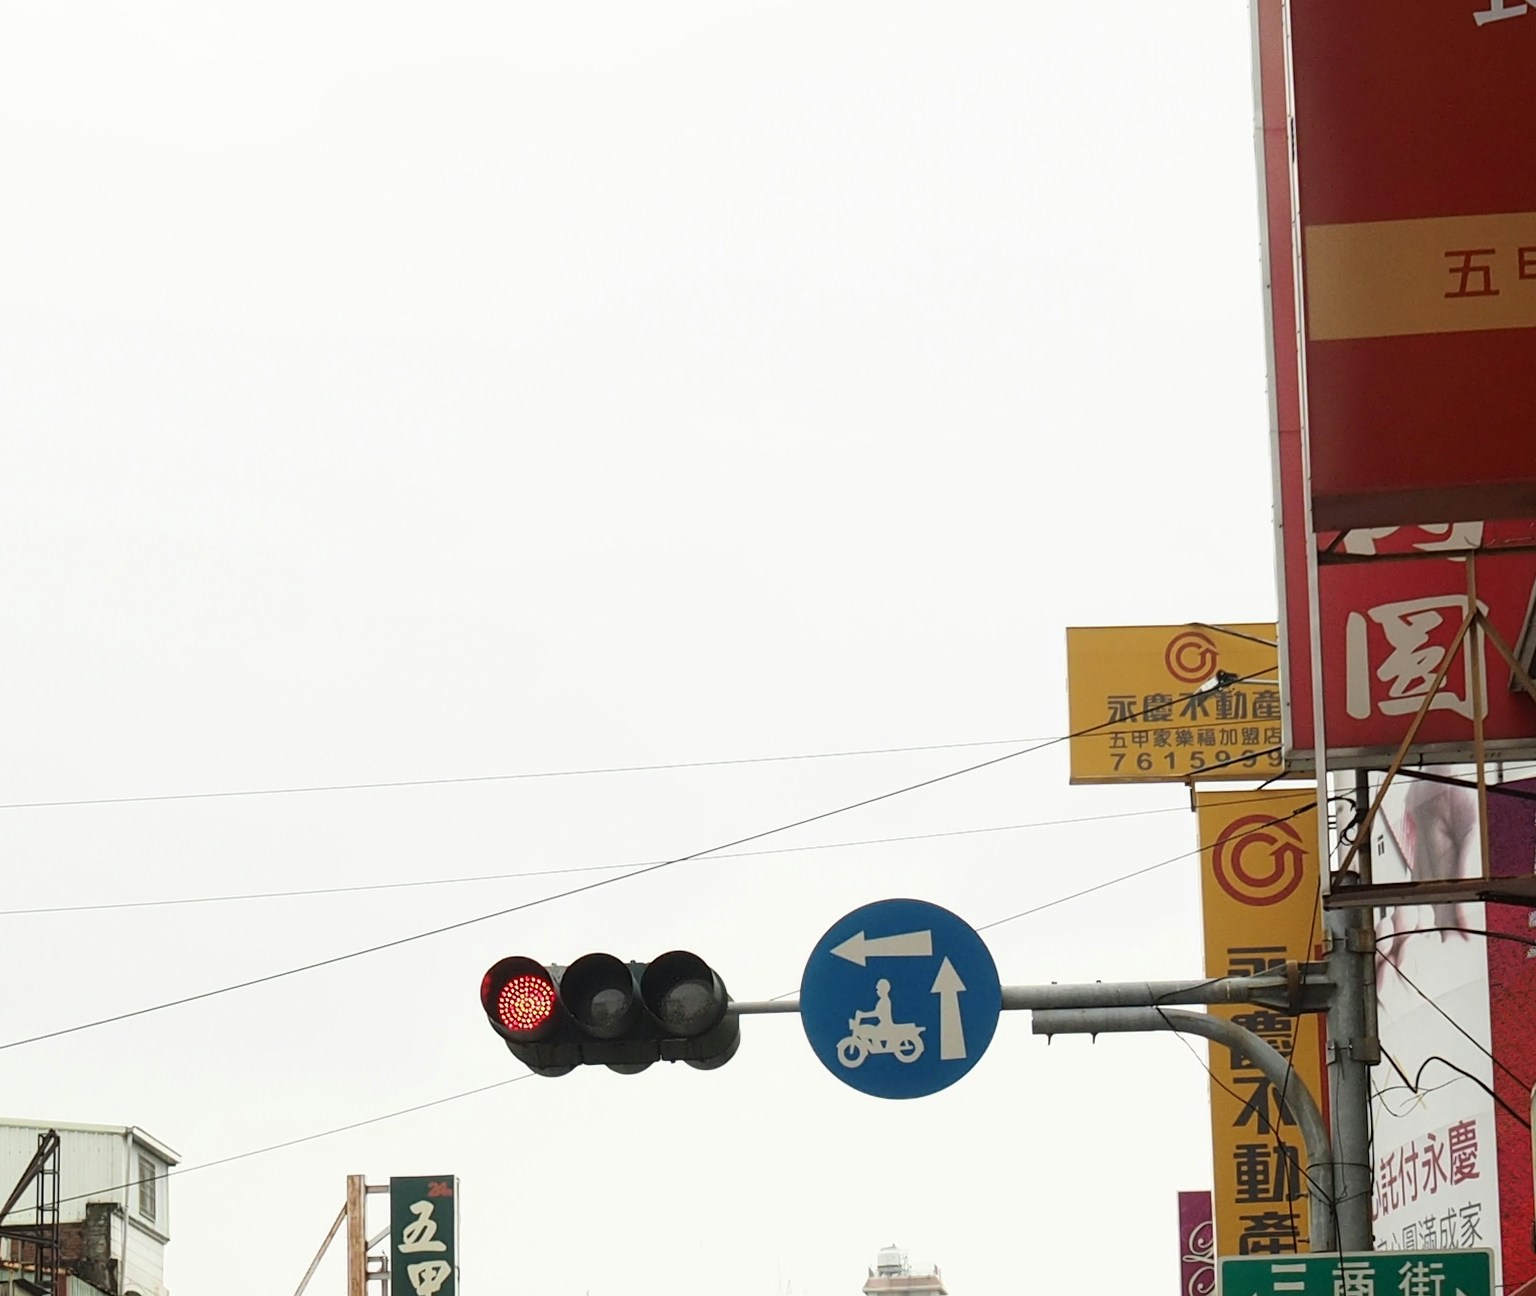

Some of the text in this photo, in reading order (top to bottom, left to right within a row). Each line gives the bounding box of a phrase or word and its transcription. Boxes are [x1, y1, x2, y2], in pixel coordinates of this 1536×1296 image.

[1107, 692, 1282, 724] 永慶不動產
[1109, 728, 1282, 750] 五甲家樂福加盟店
[1112, 750, 1284, 771] 7615999
